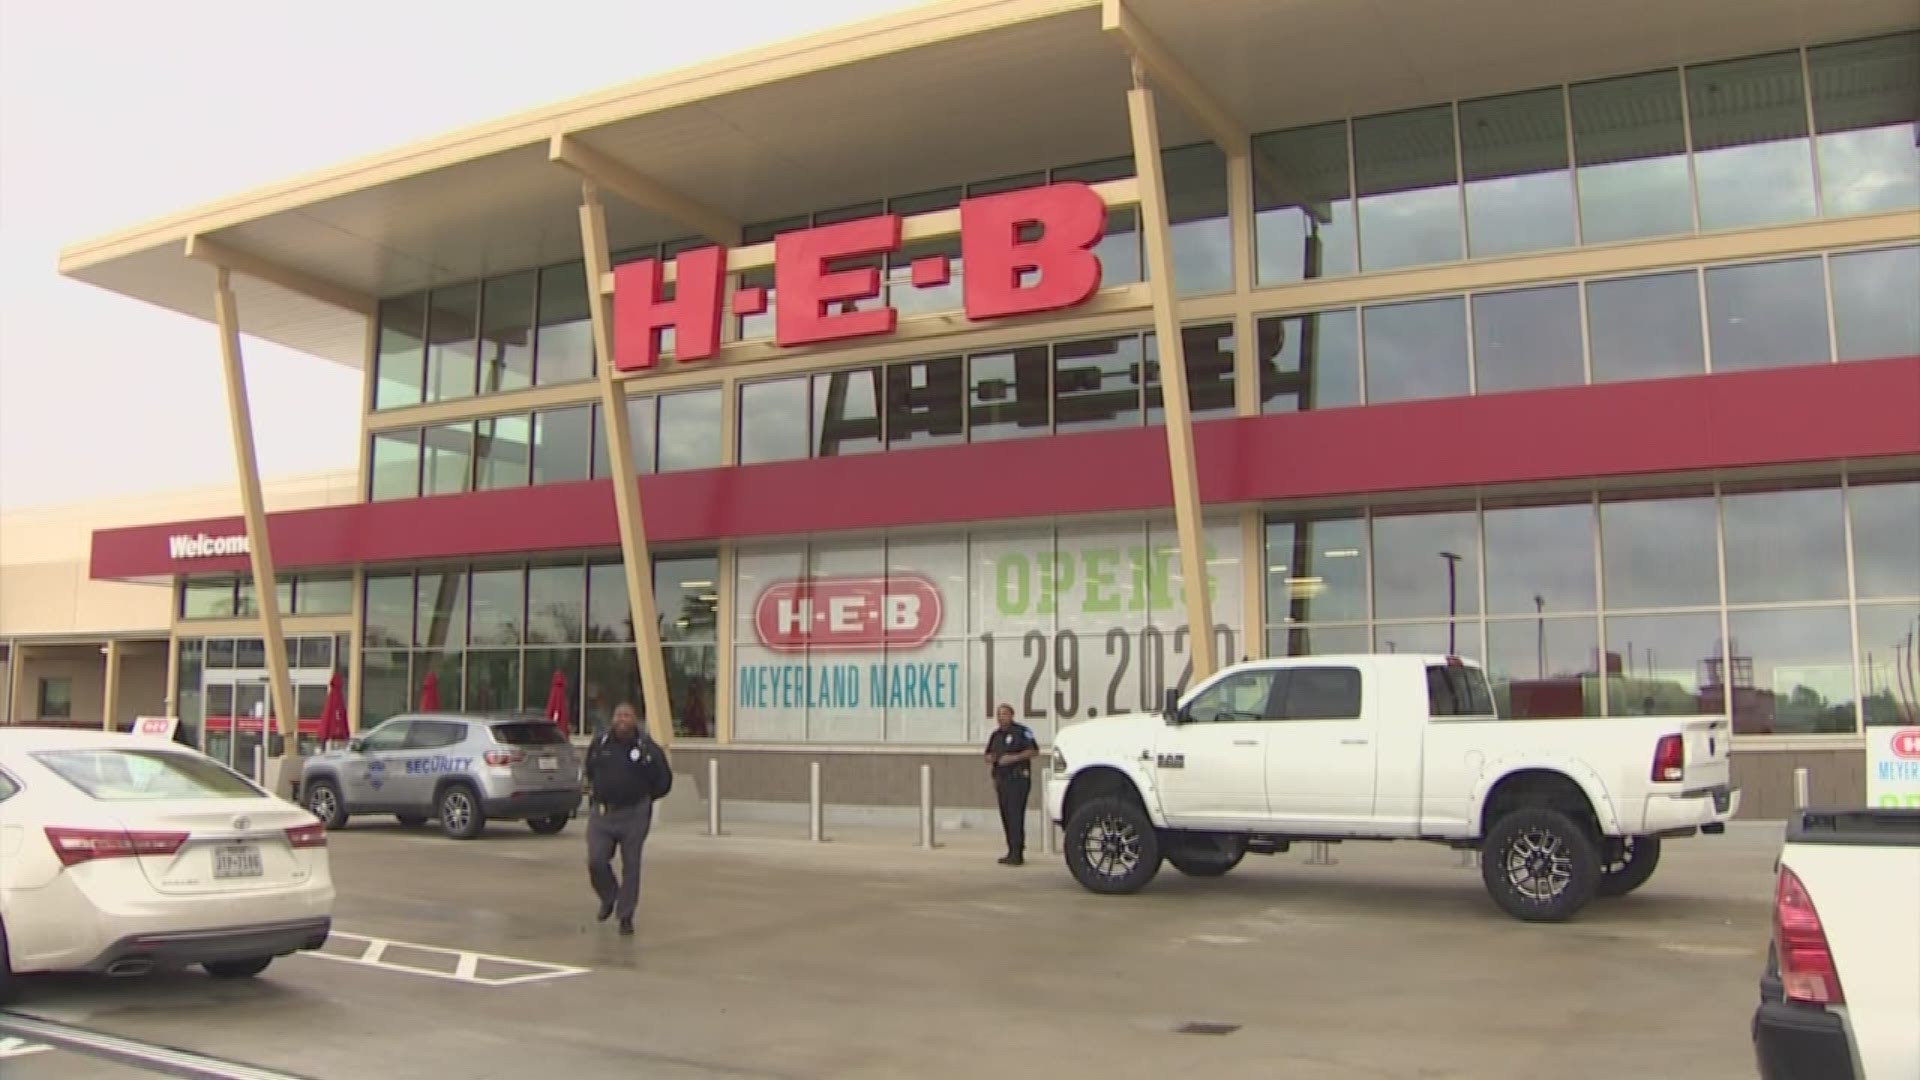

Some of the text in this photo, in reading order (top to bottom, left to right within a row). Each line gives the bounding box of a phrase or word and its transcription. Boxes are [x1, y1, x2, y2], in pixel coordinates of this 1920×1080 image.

[613, 180, 1108, 372] H-E-B
[169, 533, 249, 558] Welcom
[778, 594, 921, 635] H-E-B
[740, 661, 959, 708] MEYERLAND MARKET
[405, 756, 474, 774] SECURITY
